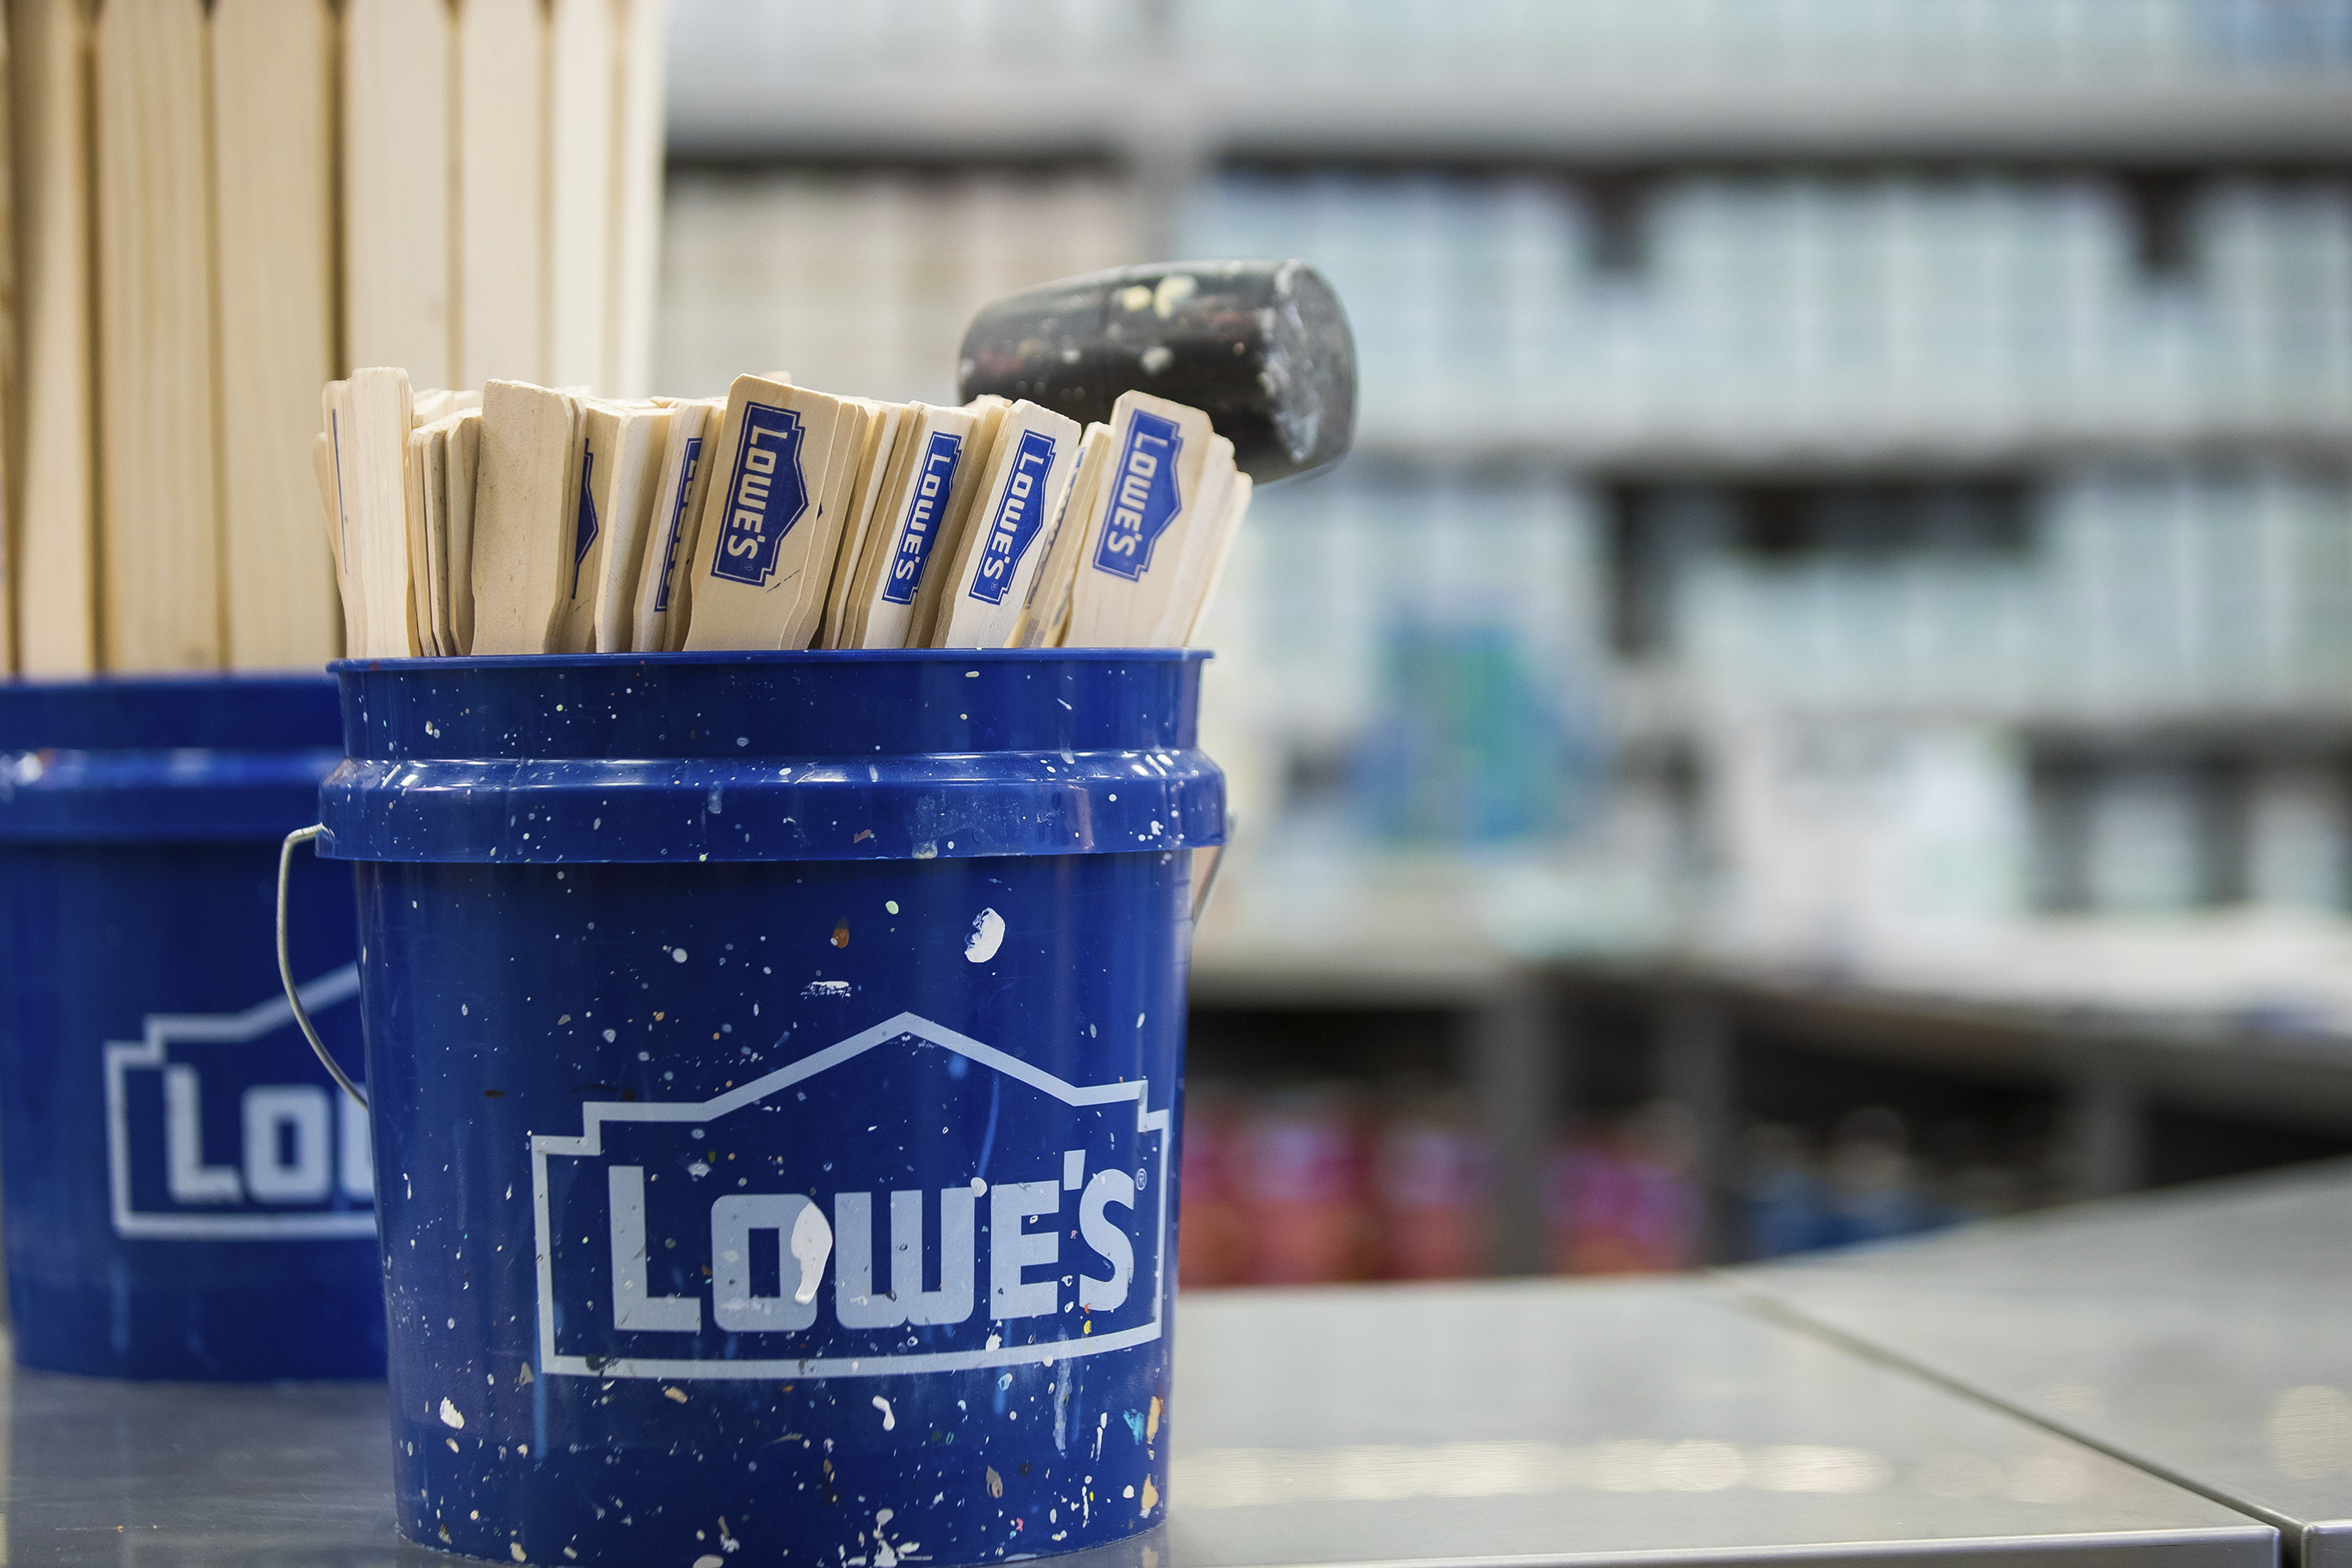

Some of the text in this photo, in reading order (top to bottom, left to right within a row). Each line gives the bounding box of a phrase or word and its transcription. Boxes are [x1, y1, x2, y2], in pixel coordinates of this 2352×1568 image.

[726, 425, 787, 561] LOWE'S
[895, 453, 951, 580] LOWE'S
[983, 451, 1044, 581] LOWE'S
[1108, 432, 1168, 557] LOWE'S
[165, 1063, 375, 1203] LO
[608, 1148, 1135, 1332] LOWE'S
